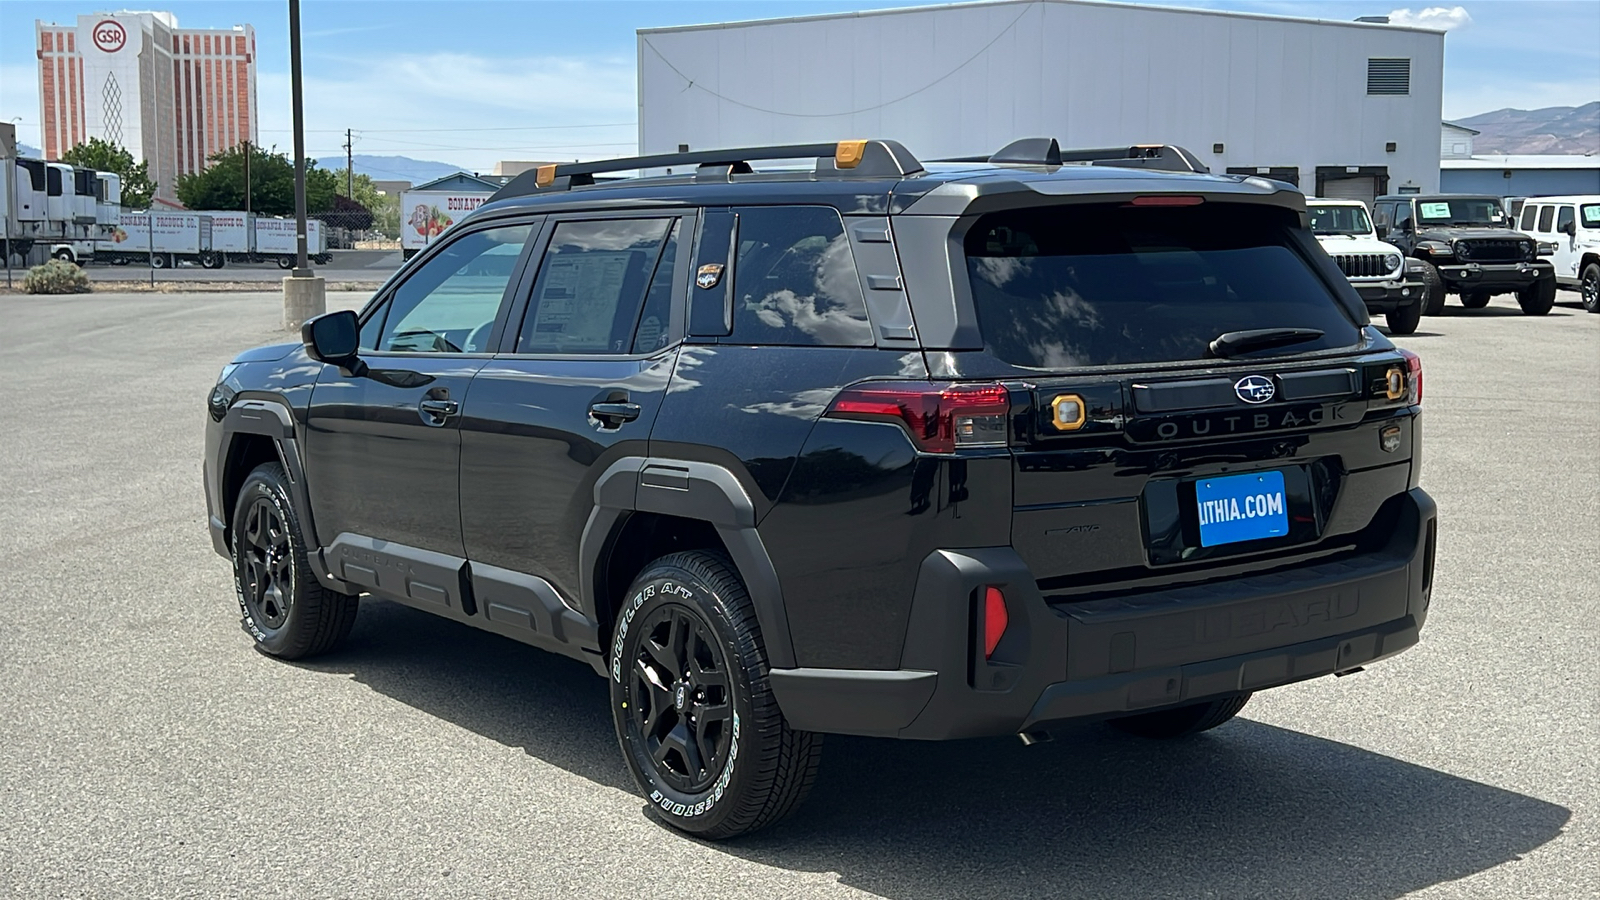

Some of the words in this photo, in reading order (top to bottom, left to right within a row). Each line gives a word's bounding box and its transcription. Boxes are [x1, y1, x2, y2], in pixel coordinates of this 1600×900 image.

[97, 29, 122, 43] GSR
[156, 217, 184, 228] PRODUCE
[1157, 405, 1346, 438] OUTBACK
[1199, 492, 1283, 526] LITHIA.COM
[341, 546, 416, 576] OUTBACK
[613, 584, 656, 683] DUELER
[661, 582, 693, 600] A/T
[650, 709, 740, 817] BRIDGESTONE
